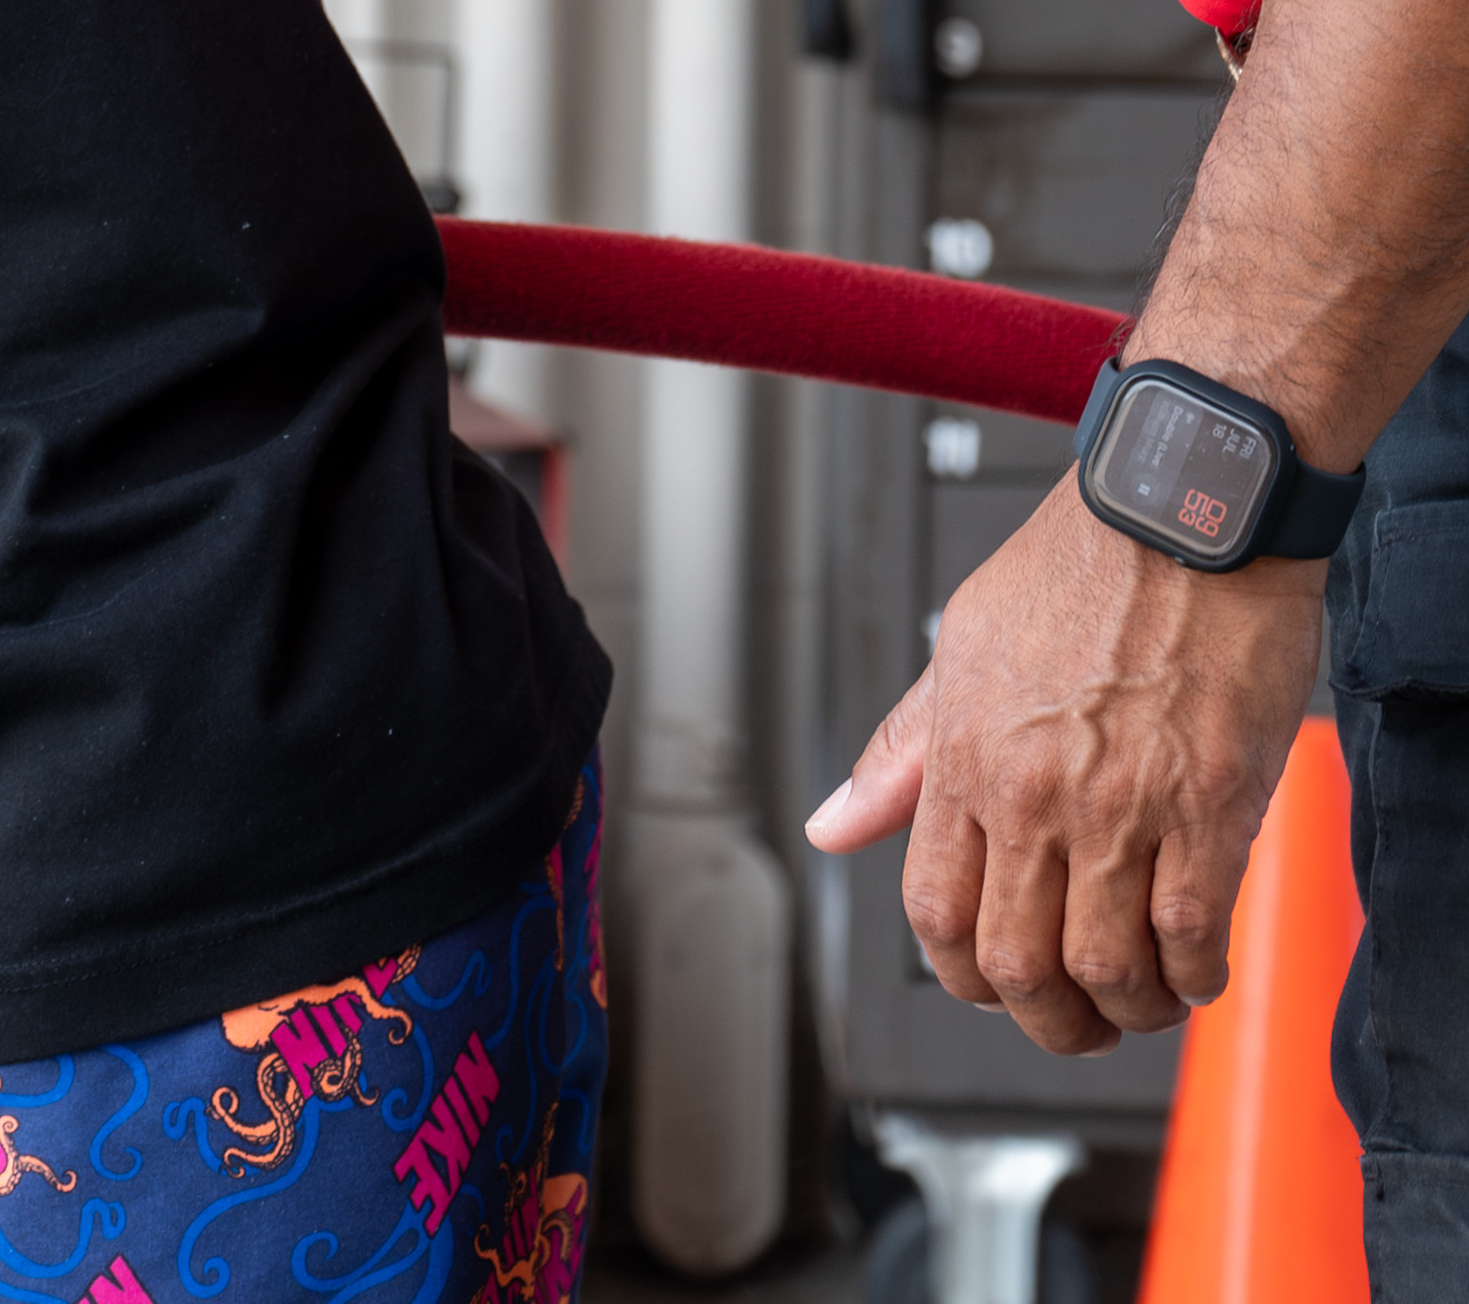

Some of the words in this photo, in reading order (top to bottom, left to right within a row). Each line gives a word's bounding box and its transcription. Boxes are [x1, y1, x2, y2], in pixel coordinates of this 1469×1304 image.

[1161, 405, 1184, 442] Double
[1212, 423, 1227, 439] 18
[1222, 427, 1240, 453] JUL
[1239, 435, 1257, 460] FRI
[1178, 488, 1210, 527] 53
[1195, 499, 1228, 538] 09
[392, 1030, 502, 1239] NIKE
